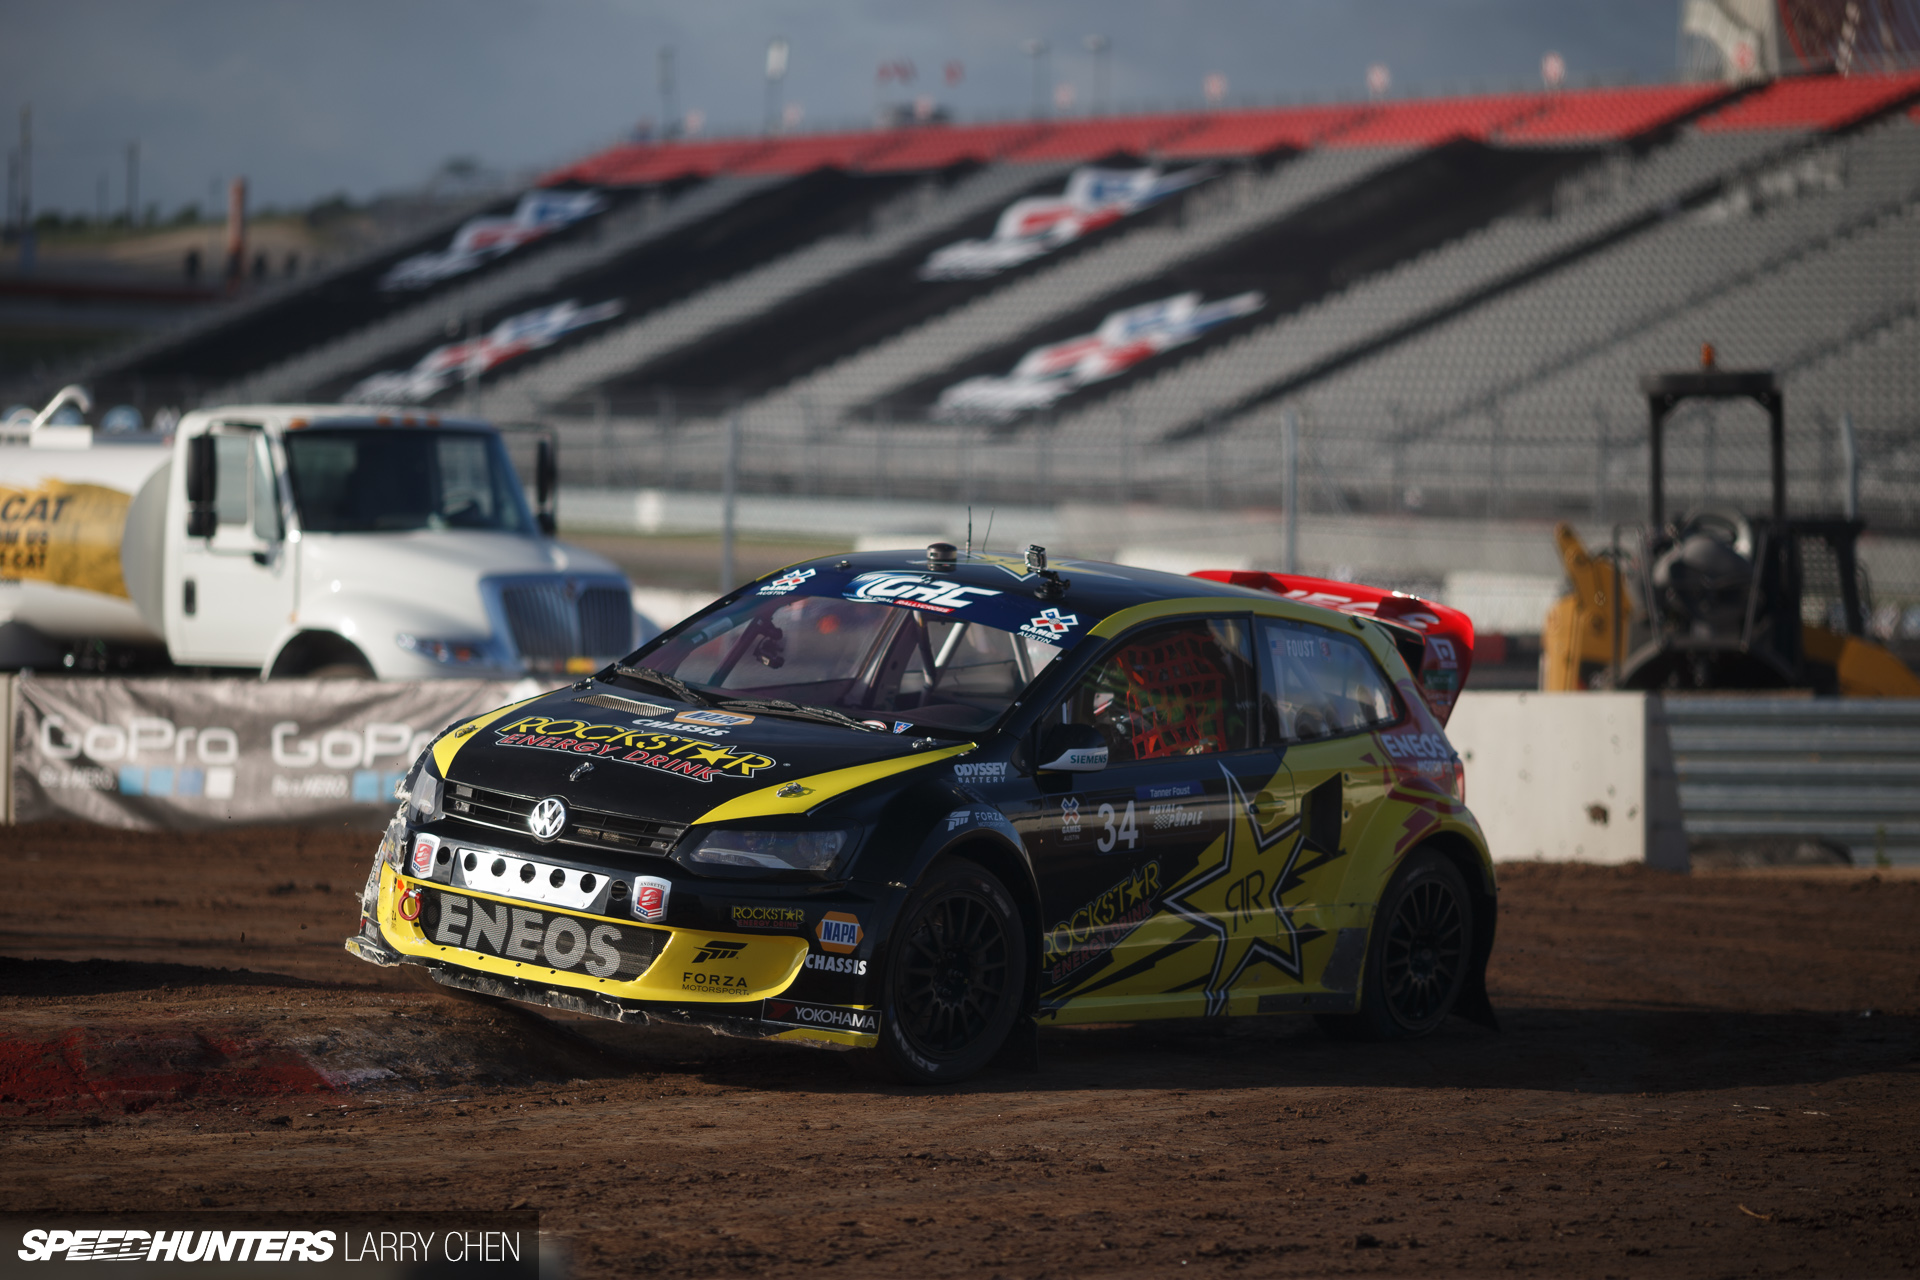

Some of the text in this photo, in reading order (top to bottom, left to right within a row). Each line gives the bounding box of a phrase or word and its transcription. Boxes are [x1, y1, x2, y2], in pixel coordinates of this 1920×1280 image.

[1, 494, 77, 523] CAT
[1017, 631, 1052, 644] AUSTIN
[1020, 624, 1062, 640] GAMES
[1286, 639, 1314, 657] FOUST
[632, 719, 730, 737] CHASSIS
[39, 715, 239, 766] GoPro
[271, 721, 432, 769] GoPr
[1380, 733, 1448, 759] ENEOS
[502, 734, 722, 780] ENERGY DRINK
[1070, 753, 1107, 765] SIEMENS
[953, 762, 1007, 776] ODYSSEY
[958, 776, 1005, 784] BATTERY
[1150, 785, 1191, 798] Tanner Foust
[974, 811, 1005, 822] FORZA
[1149, 803, 1175, 815] ROYAL
[1096, 800, 1139, 853] 34
[1168, 810, 1203, 828] PURPLE
[1062, 825, 1081, 834] GAMES
[1063, 834, 1080, 842] AUSTIN
[738, 919, 798, 929] ENERGY DRINK
[822, 920, 858, 944] NAPA
[435, 892, 622, 978] ENEOS
[1053, 898, 1150, 980] ENERGY DRINK
[805, 953, 867, 975] CHASSIS
[682, 971, 748, 988] FORZA
[682, 983, 748, 995] MOTORSPORT
[795, 1006, 876, 1029] YOKOHAMA
